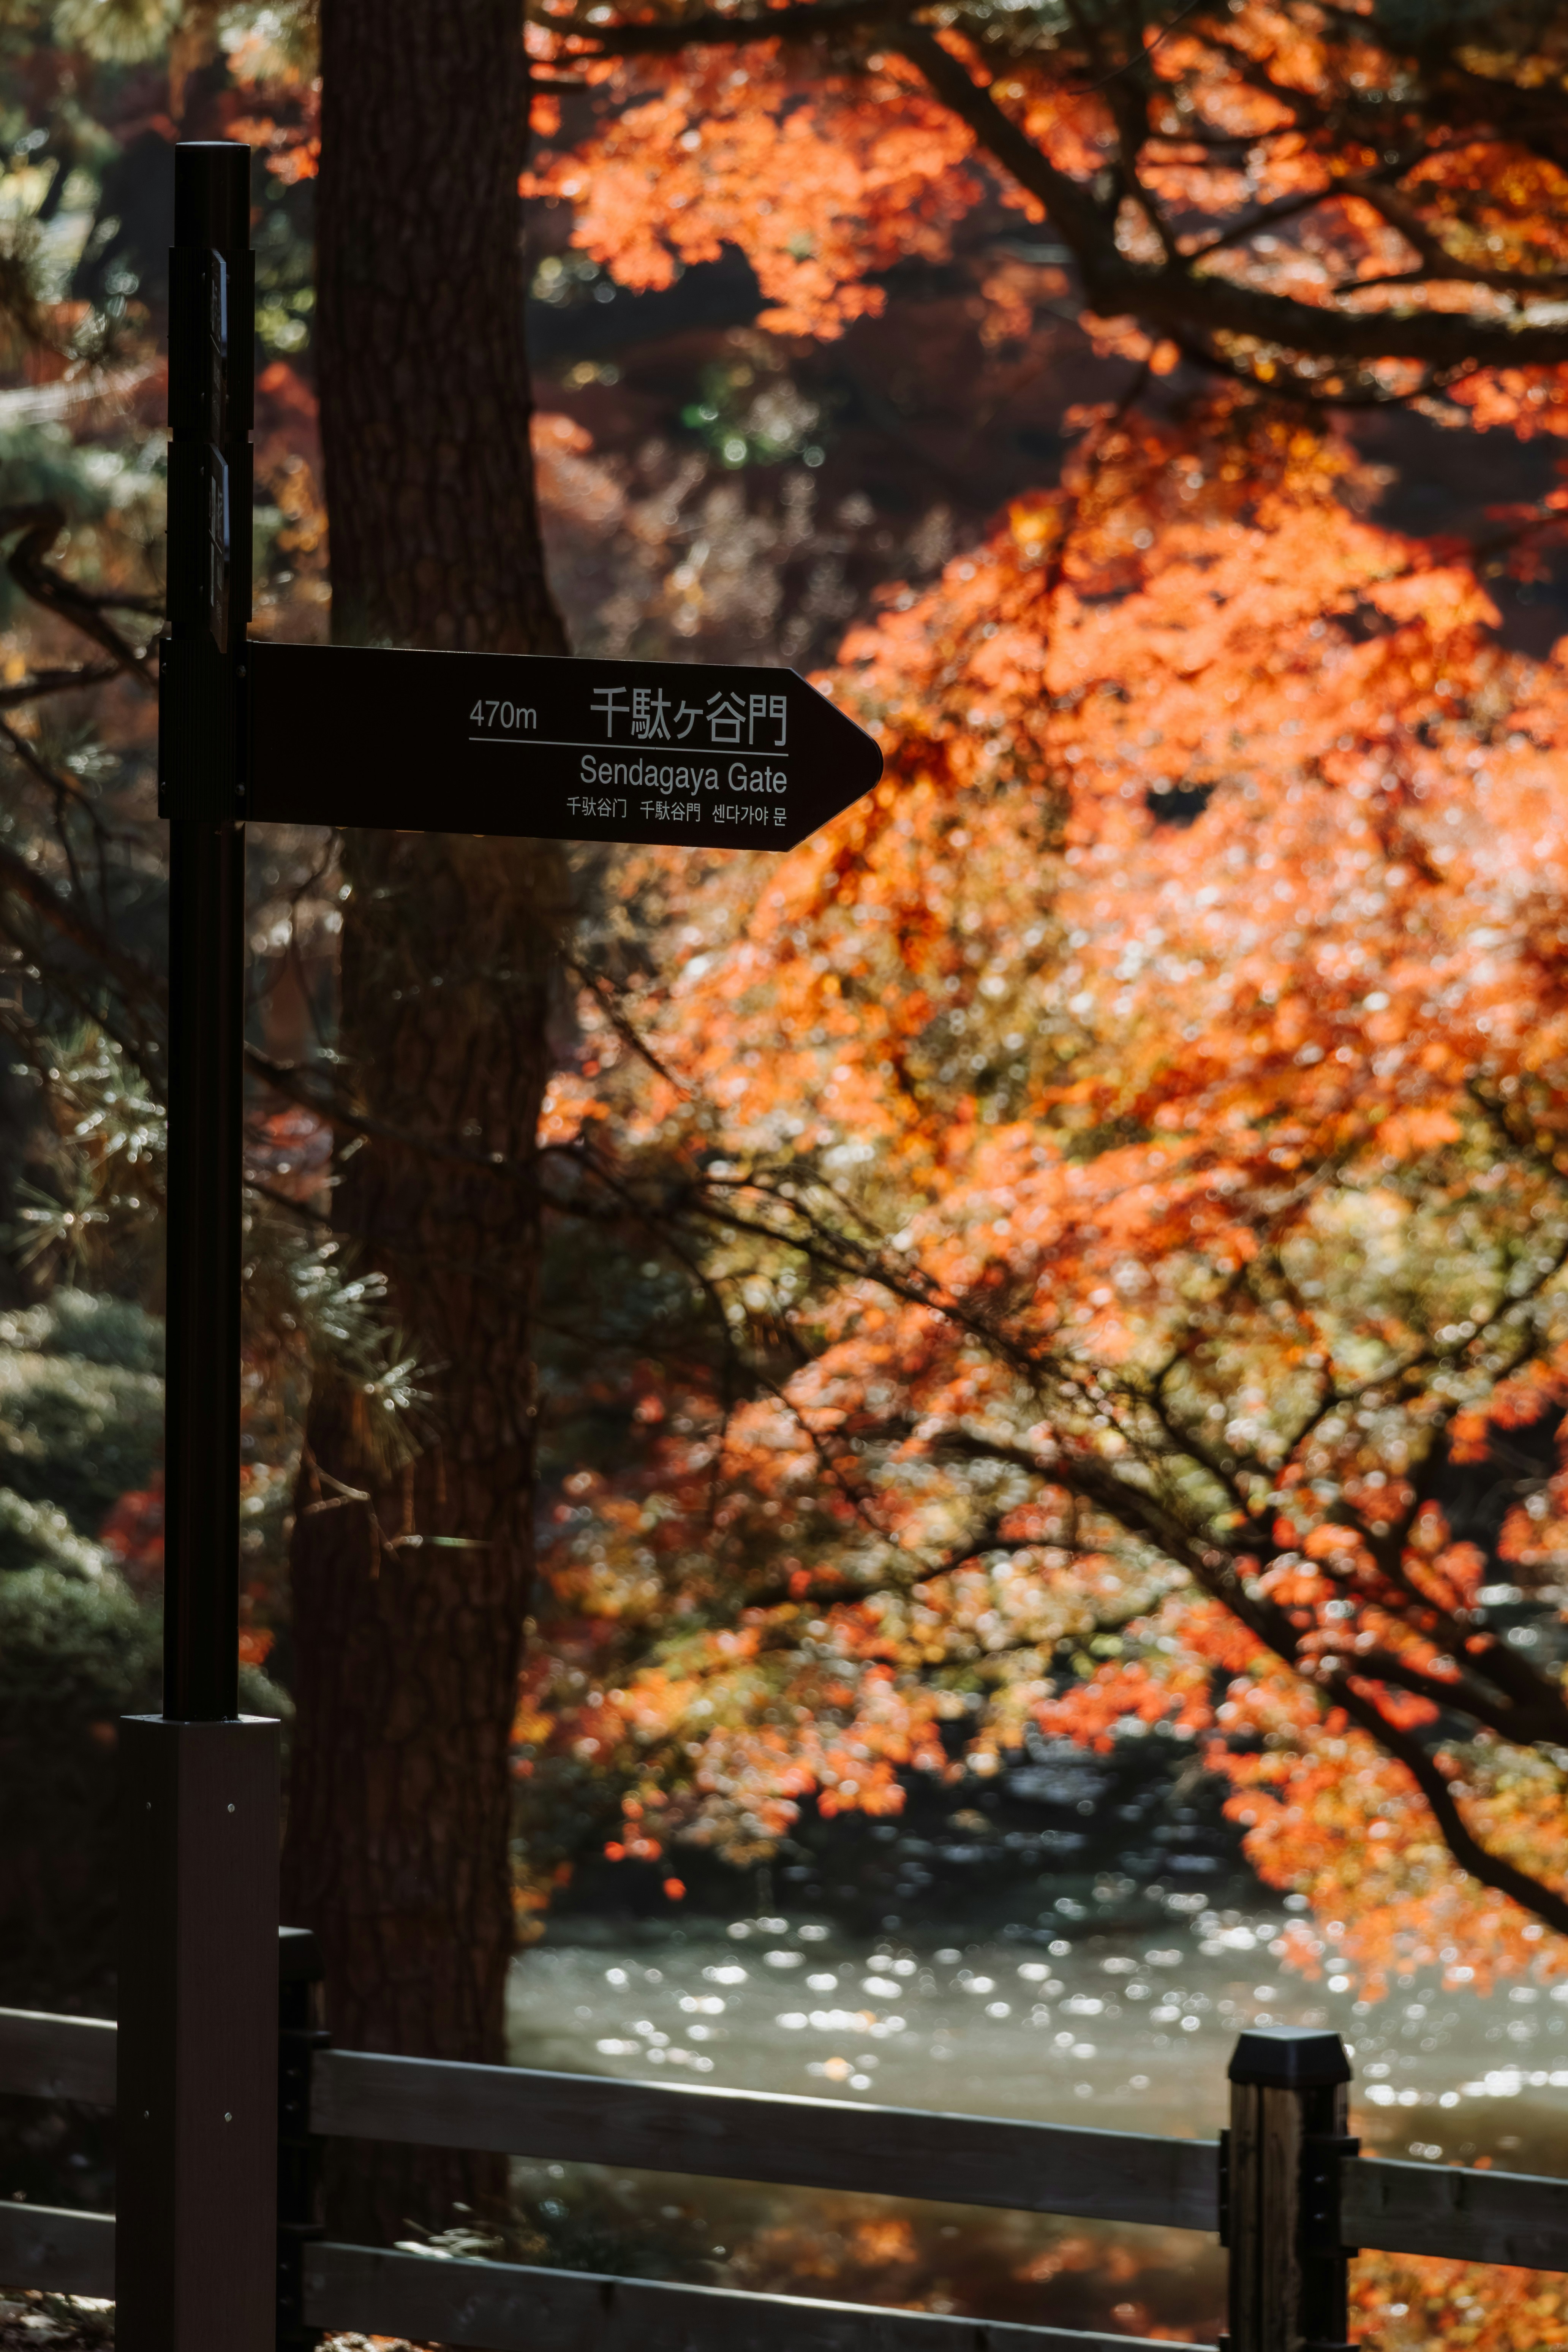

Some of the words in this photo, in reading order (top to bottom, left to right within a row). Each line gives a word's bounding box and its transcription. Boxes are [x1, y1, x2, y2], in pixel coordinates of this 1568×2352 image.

[470, 699, 537, 729] 470m
[580, 754, 719, 796] Sendagaya
[728, 762, 787, 794] Gate
[712, 805, 769, 826] 센다가야
[773, 807, 787, 827] 문
